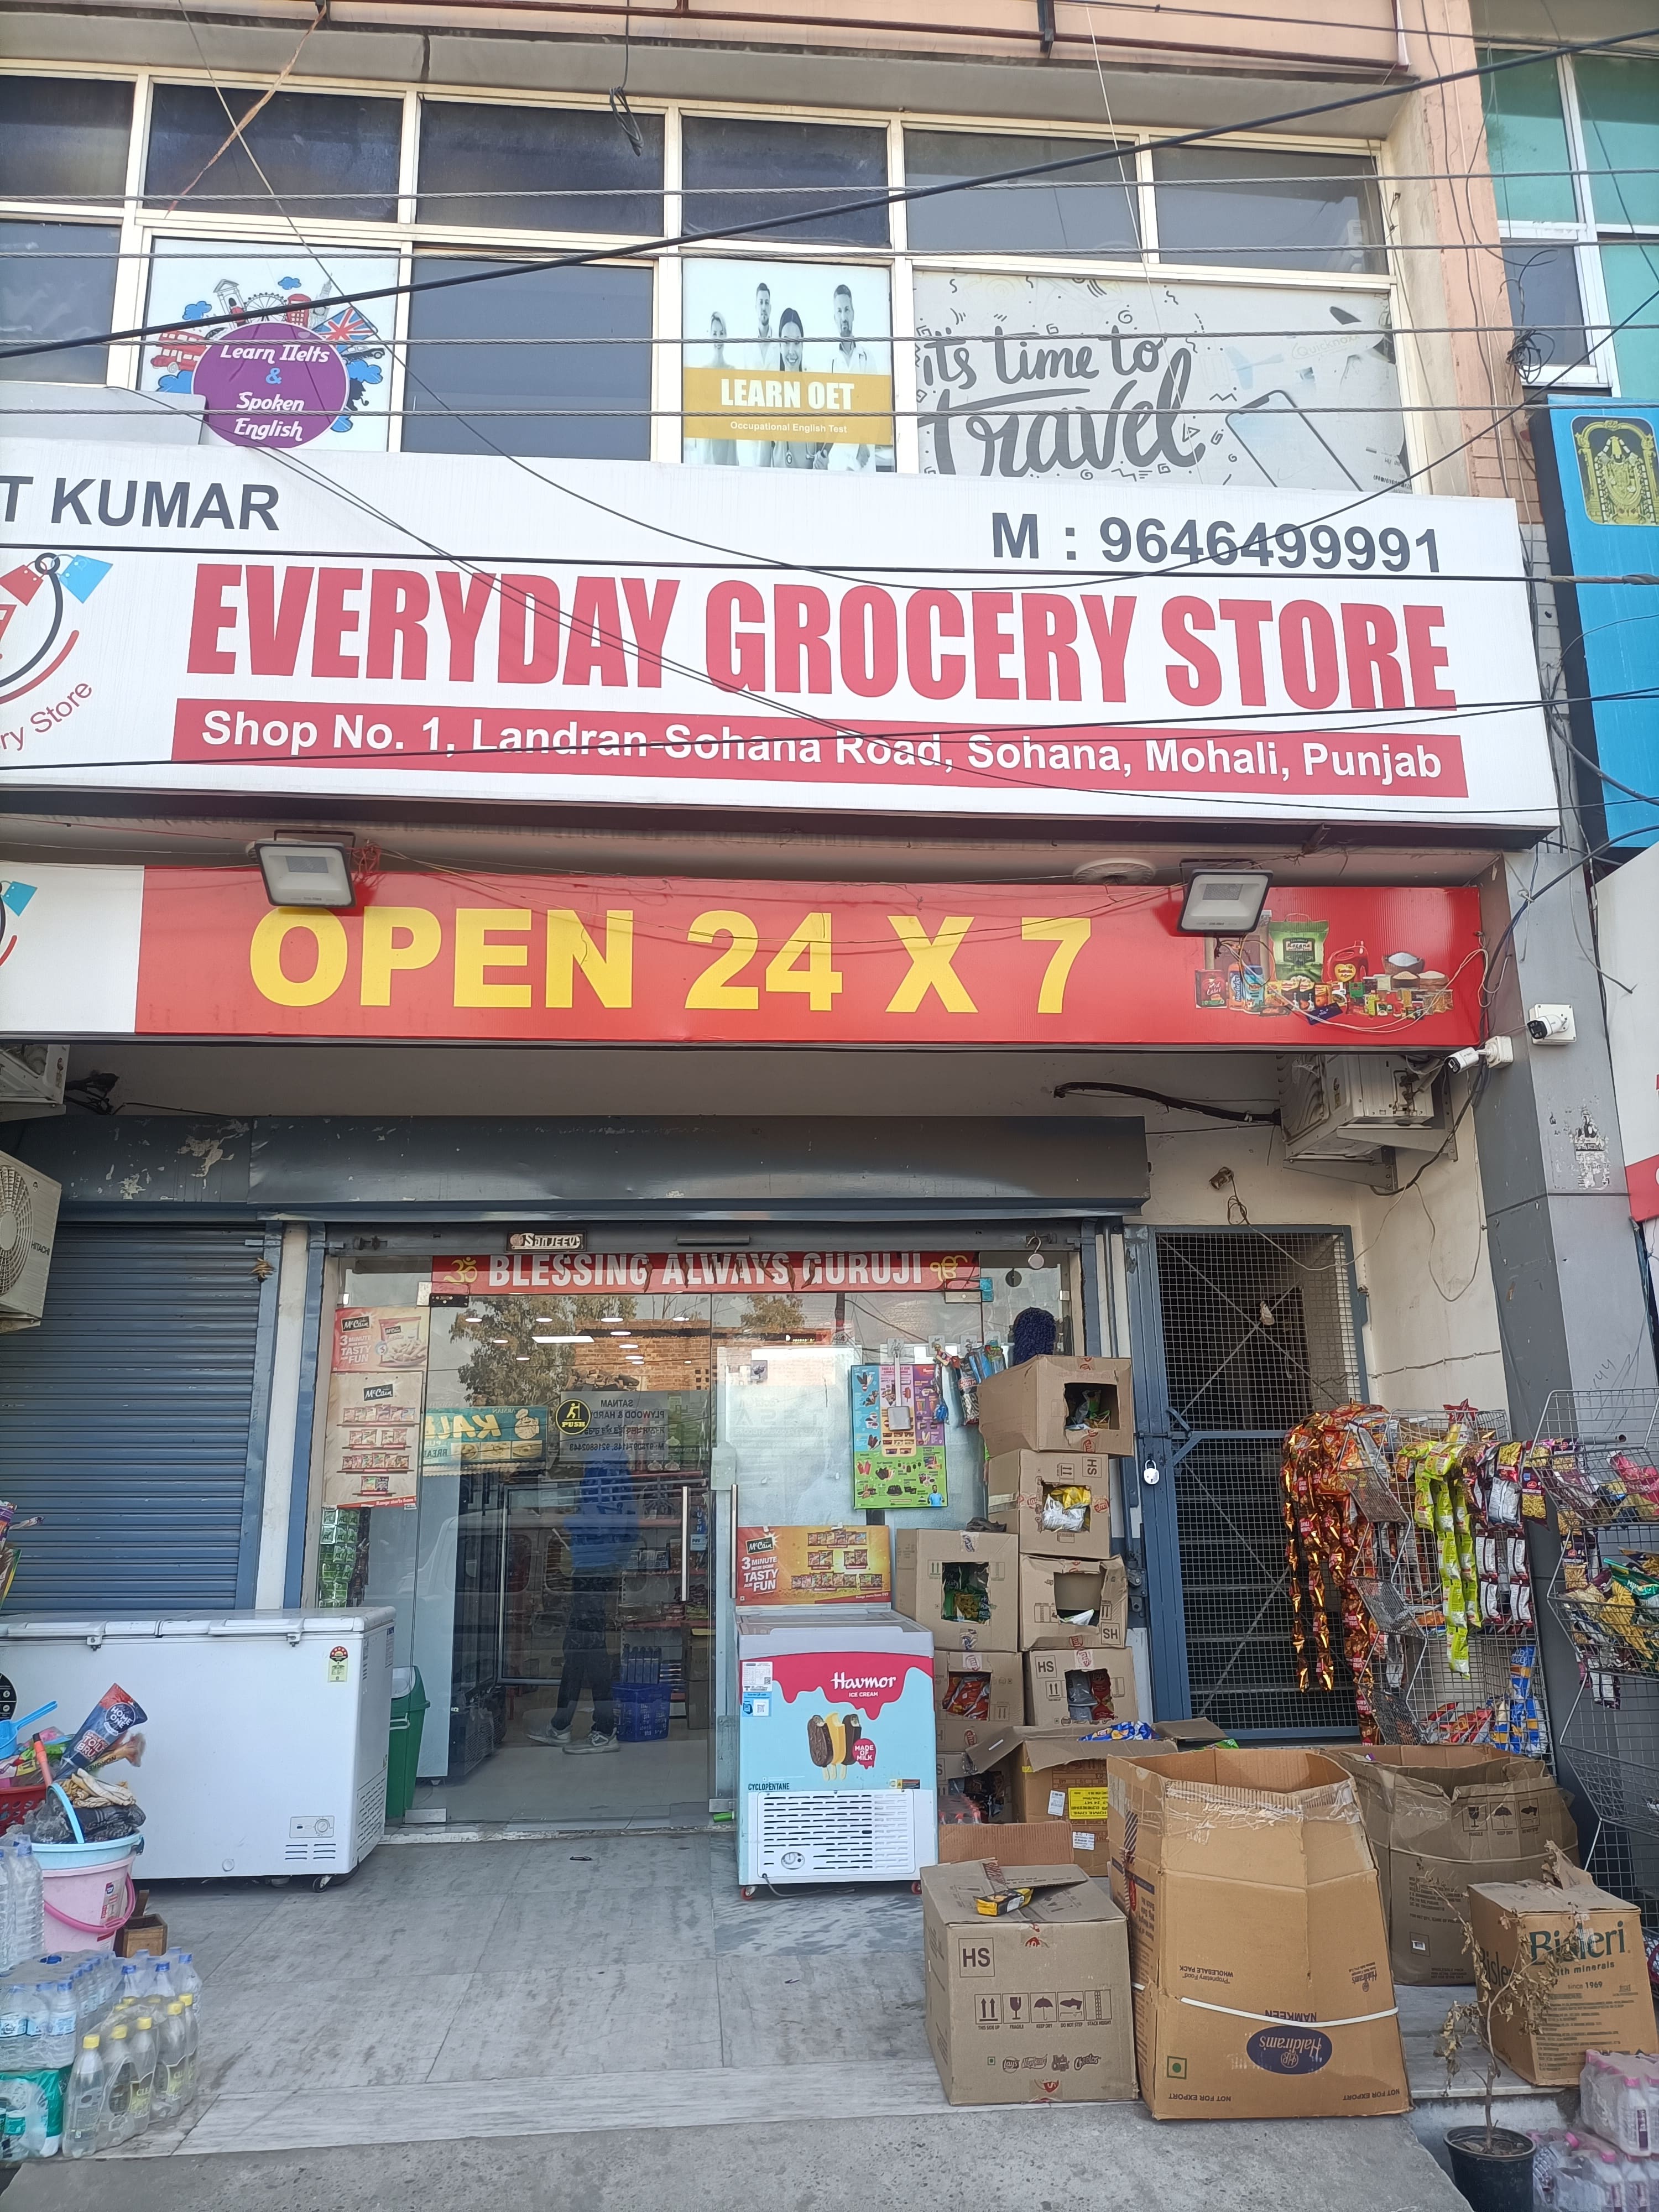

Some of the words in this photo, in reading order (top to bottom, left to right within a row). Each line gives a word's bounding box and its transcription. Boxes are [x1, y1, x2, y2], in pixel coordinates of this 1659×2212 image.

[220, 345, 275, 364] Learn
[982, 326, 1099, 385] time
[1098, 325, 1168, 376] to
[265, 367, 282, 384] &
[236, 392, 305, 412] Spoken
[721, 378, 801, 409] LEARN
[808, 383, 855, 410] OET
[917, 347, 1206, 476] travel
[233, 418, 303, 442] English
[730, 421, 790, 434] Occupational
[792, 423, 826, 435] English
[828, 424, 848, 433] Test
[51, 478, 280, 531] KUMAR
[992, 513, 1040, 559] M
[1099, 517, 1440, 573] 9646499991
[187, 563, 681, 688] EVERYDAY
[706, 580, 1137, 703] GROCERY
[1161, 595, 1457, 711] STORE
[30, 683, 92, 733] Store
[202, 710, 318, 756] Shop
[333, 714, 404, 750] No.
[422, 717, 456, 758] 1,
[836, 731, 953, 774] Road,
[967, 734, 1131, 777] Sohana,
[1146, 739, 1289, 781] Mohali,
[1302, 742, 1442, 785] Punjab
[249, 905, 634, 1008] OPEN
[684, 910, 843, 1011] 24
[884, 916, 979, 1014] X
[1020, 917, 1092, 1014] 7
[30, 1240, 51, 1257] HITACHI
[489, 1253, 651, 1287] BLESSING
[662, 1253, 790, 1286] ALWAYS
[802, 1252, 922, 1285] GURUJI
[343, 1319, 369, 1330] McCain
[340, 1334, 348, 1346] 3
[340, 1345, 372, 1355] TASTY
[348, 1355, 369, 1364] FUN
[364, 1387, 393, 1399] McCain
[1087, 1459, 1097, 1475] HS
[748, 1542, 773, 1552] McCain
[741, 1557, 751, 1571] 3
[751, 1556, 778, 1564] MINUTE
[743, 1568, 779, 1583] TASTY
[753, 1579, 776, 1592] FUN
[1037, 1660, 1055, 1673] HS
[830, 1671, 898, 1691] Havmor
[110, 1706, 133, 1726] HOME
[110, 1713, 126, 1729] ONE
[854, 1744, 874, 1752] MADE
[748, 1782, 790, 1791] CYCLOPENTANE
[962, 1947, 991, 1968] HS
[1179, 1965, 1196, 1973] PACK
[1197, 1967, 1234, 1978] WHOLESALE
[1573, 1961, 1615, 1974] minerals
[1585, 1981, 1603, 1989] 1969
[1264, 2009, 1317, 2022] NAMKEEN
[1259, 2035, 1322, 2058] Haldiram's
[1371, 2090, 1386, 2099] FOR
[1386, 2088, 1400, 2096] NOT
